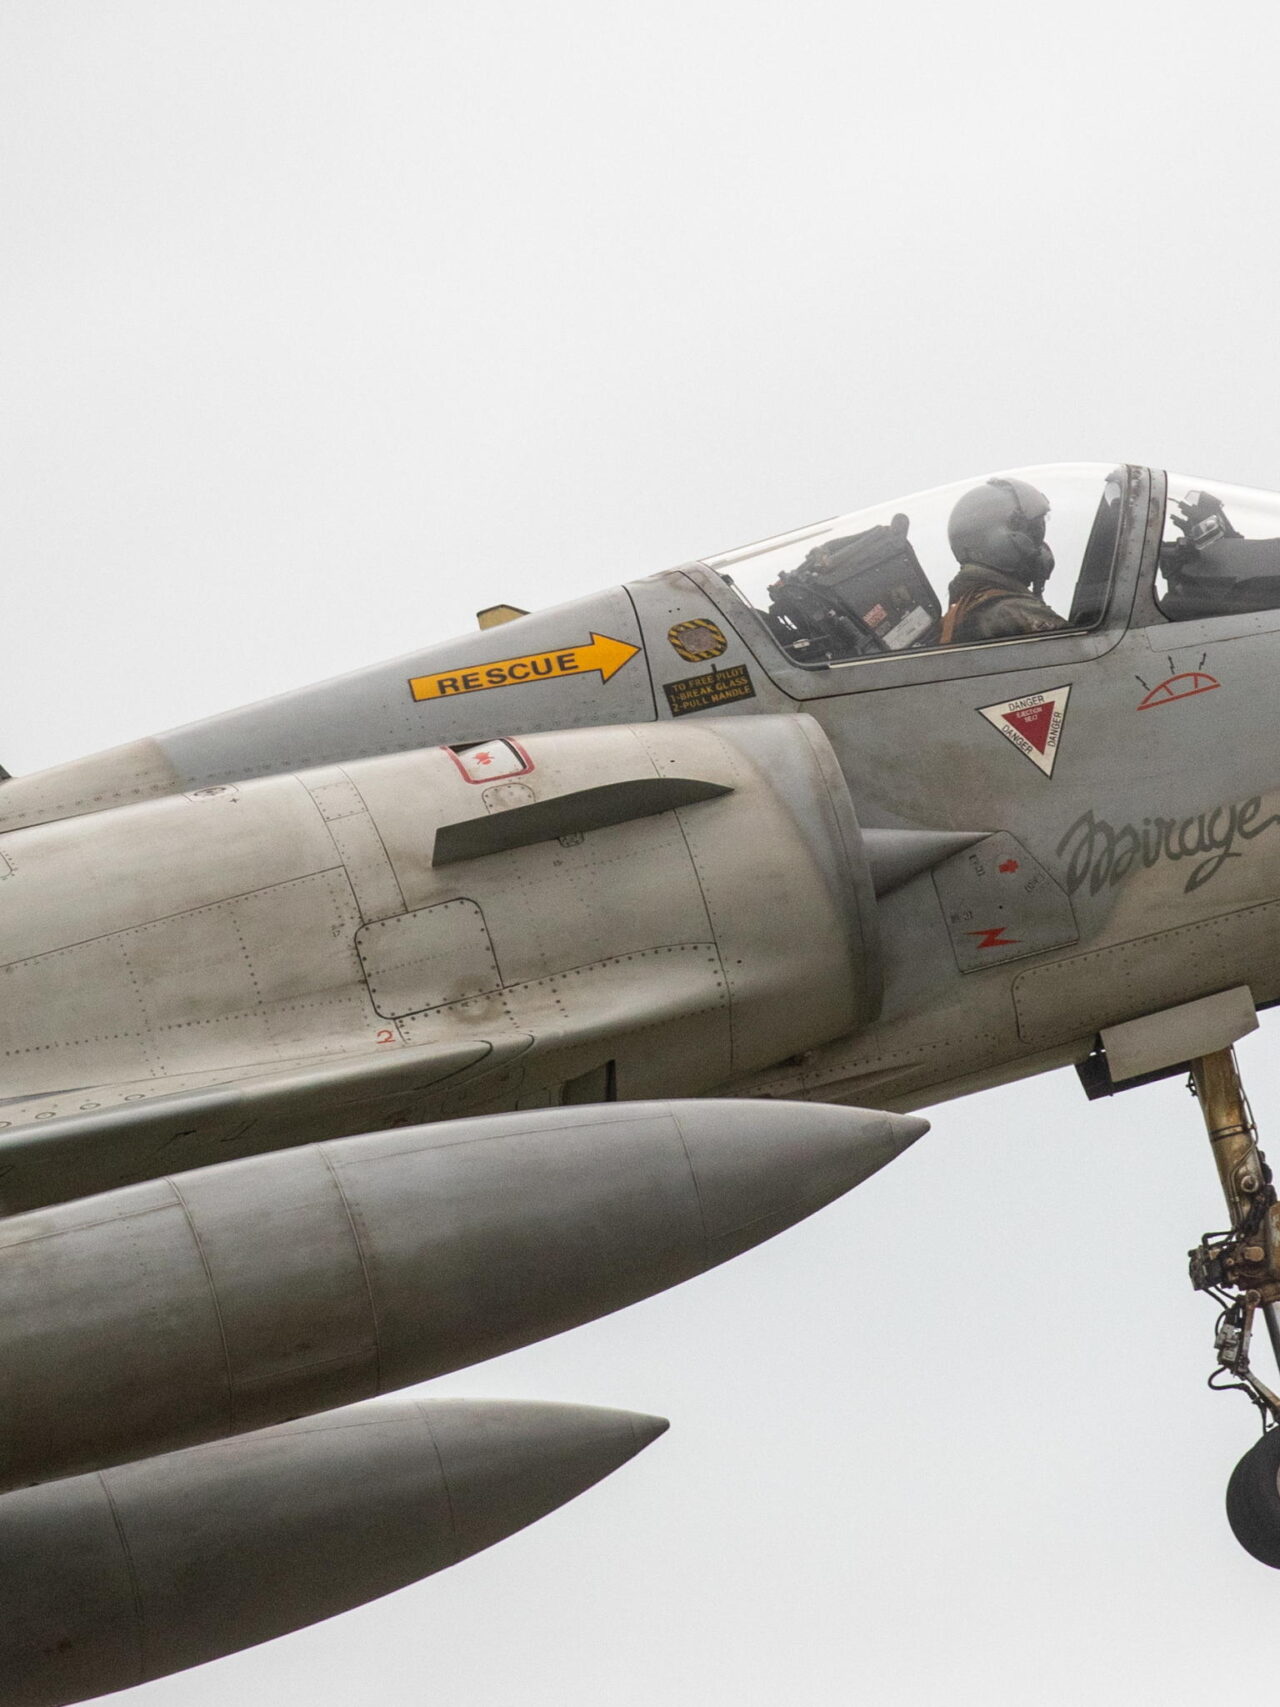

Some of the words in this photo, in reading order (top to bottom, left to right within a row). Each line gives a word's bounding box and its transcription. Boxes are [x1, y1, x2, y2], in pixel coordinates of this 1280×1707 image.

[437, 652, 580, 695] RESCUE
[672, 683, 686, 692] TO
[689, 676, 713, 687] FREE
[717, 668, 744, 680] PILOT
[716, 678, 748, 690] GLASS
[673, 697, 708, 712] 2-PULL
[711, 686, 751, 702] HANDLE
[1008, 695, 1045, 712] DANGER
[1001, 724, 1034, 755] DANGER
[1047, 711, 1063, 748] DANGER
[376, 1029, 396, 1044] 2
